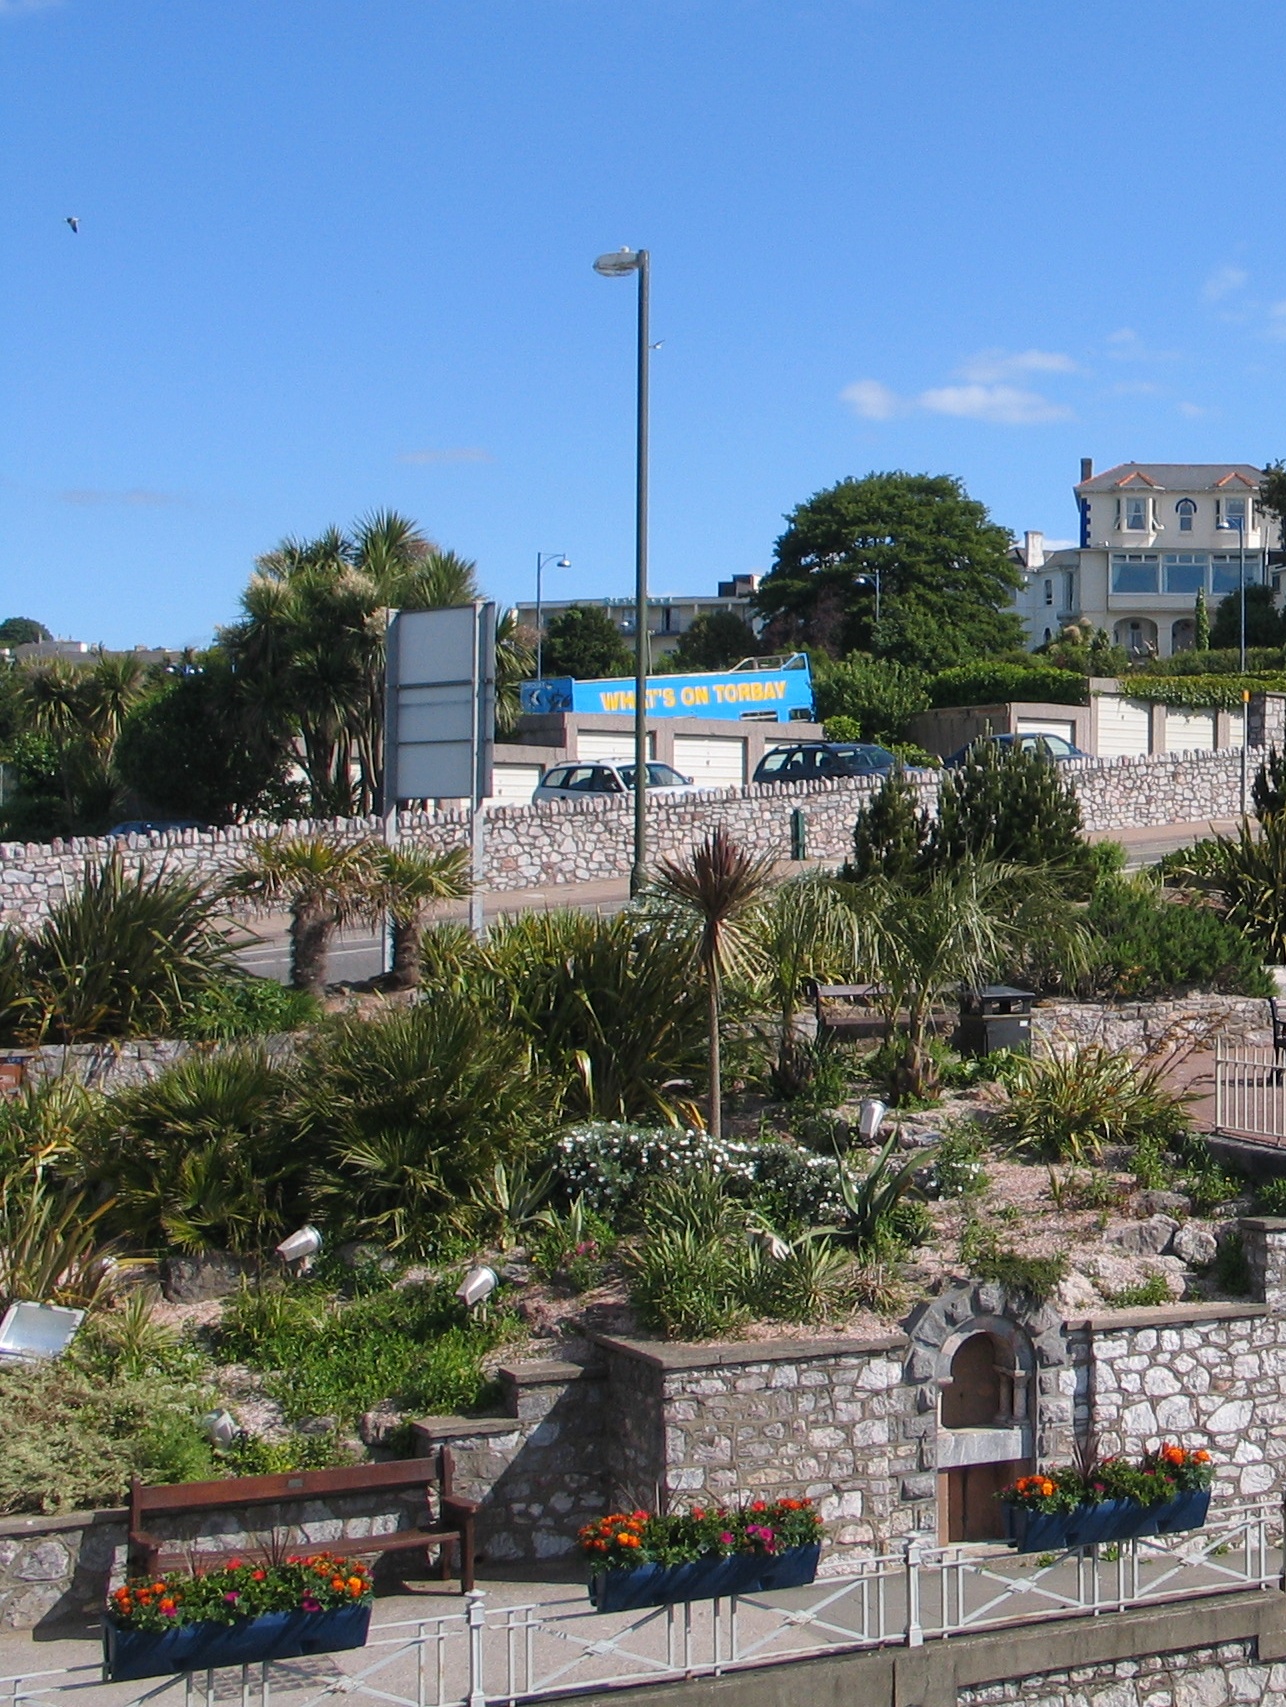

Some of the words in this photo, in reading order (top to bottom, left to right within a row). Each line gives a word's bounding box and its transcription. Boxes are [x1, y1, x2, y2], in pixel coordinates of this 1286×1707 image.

[600, 688, 677, 711] WHT'S
[680, 685, 710, 706] ON
[712, 681, 788, 703] TORBAY
